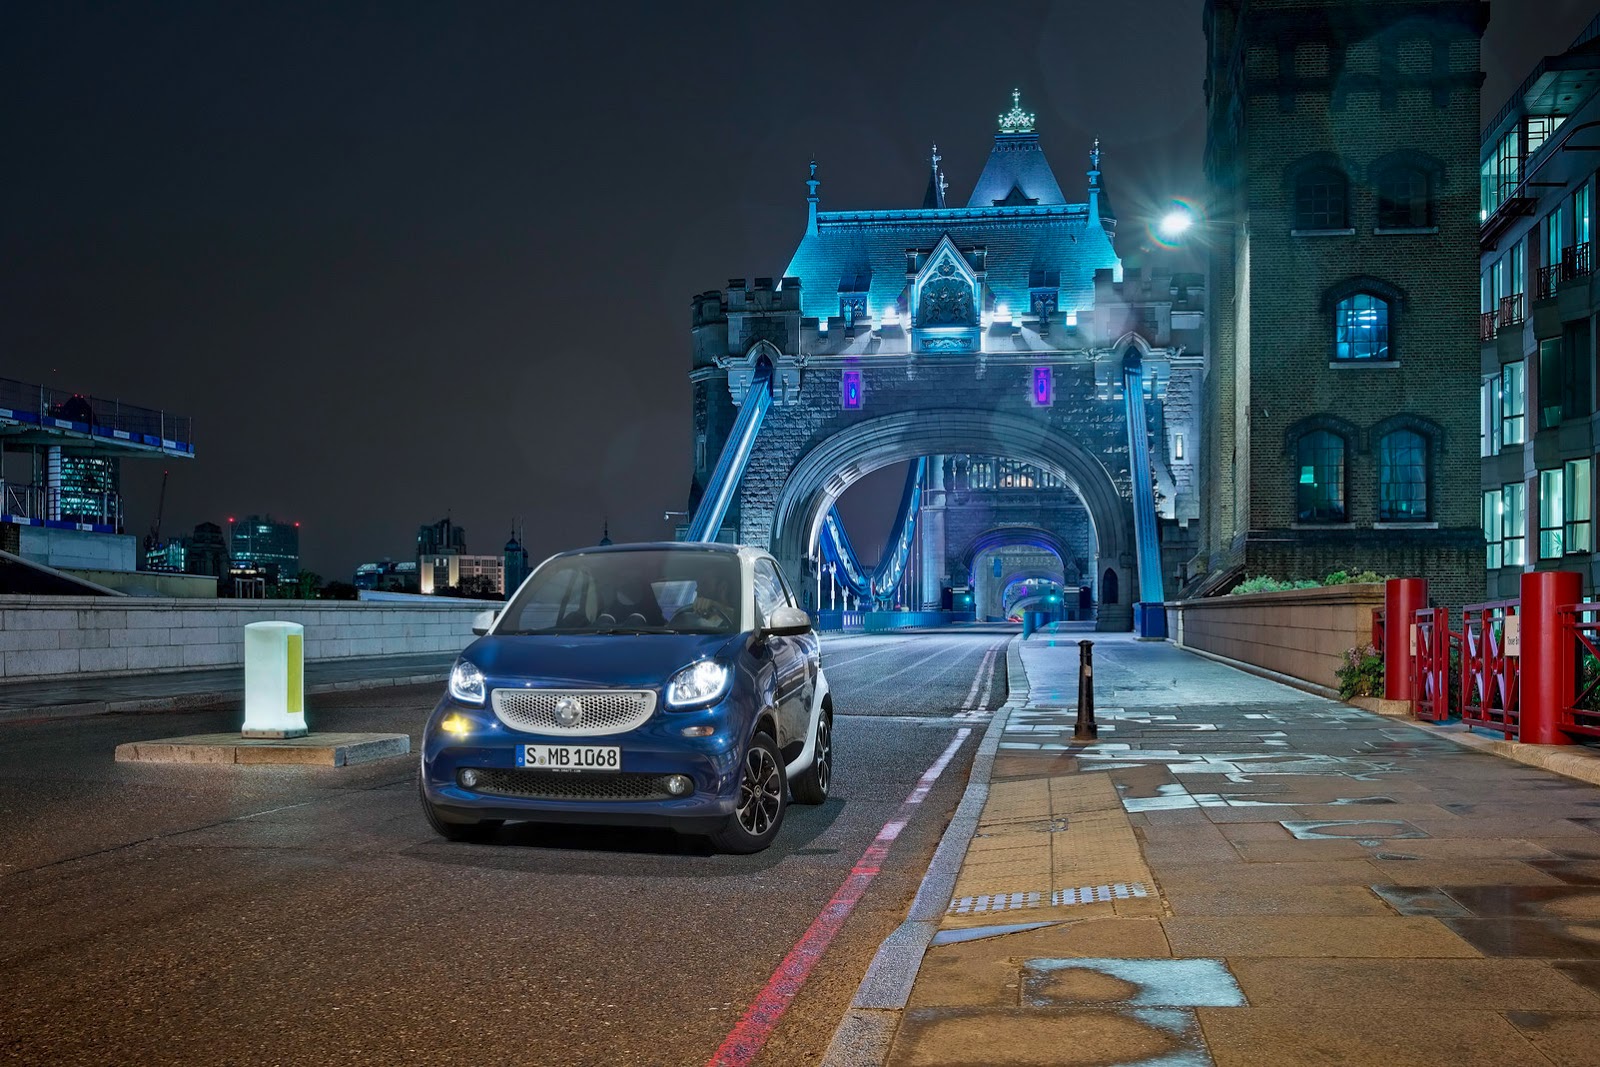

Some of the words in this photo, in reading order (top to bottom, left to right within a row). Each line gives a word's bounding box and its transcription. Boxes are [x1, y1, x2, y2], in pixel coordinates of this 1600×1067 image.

[526, 747, 537, 764] S
[548, 748, 570, 765] MB
[574, 749, 617, 766] 1068
